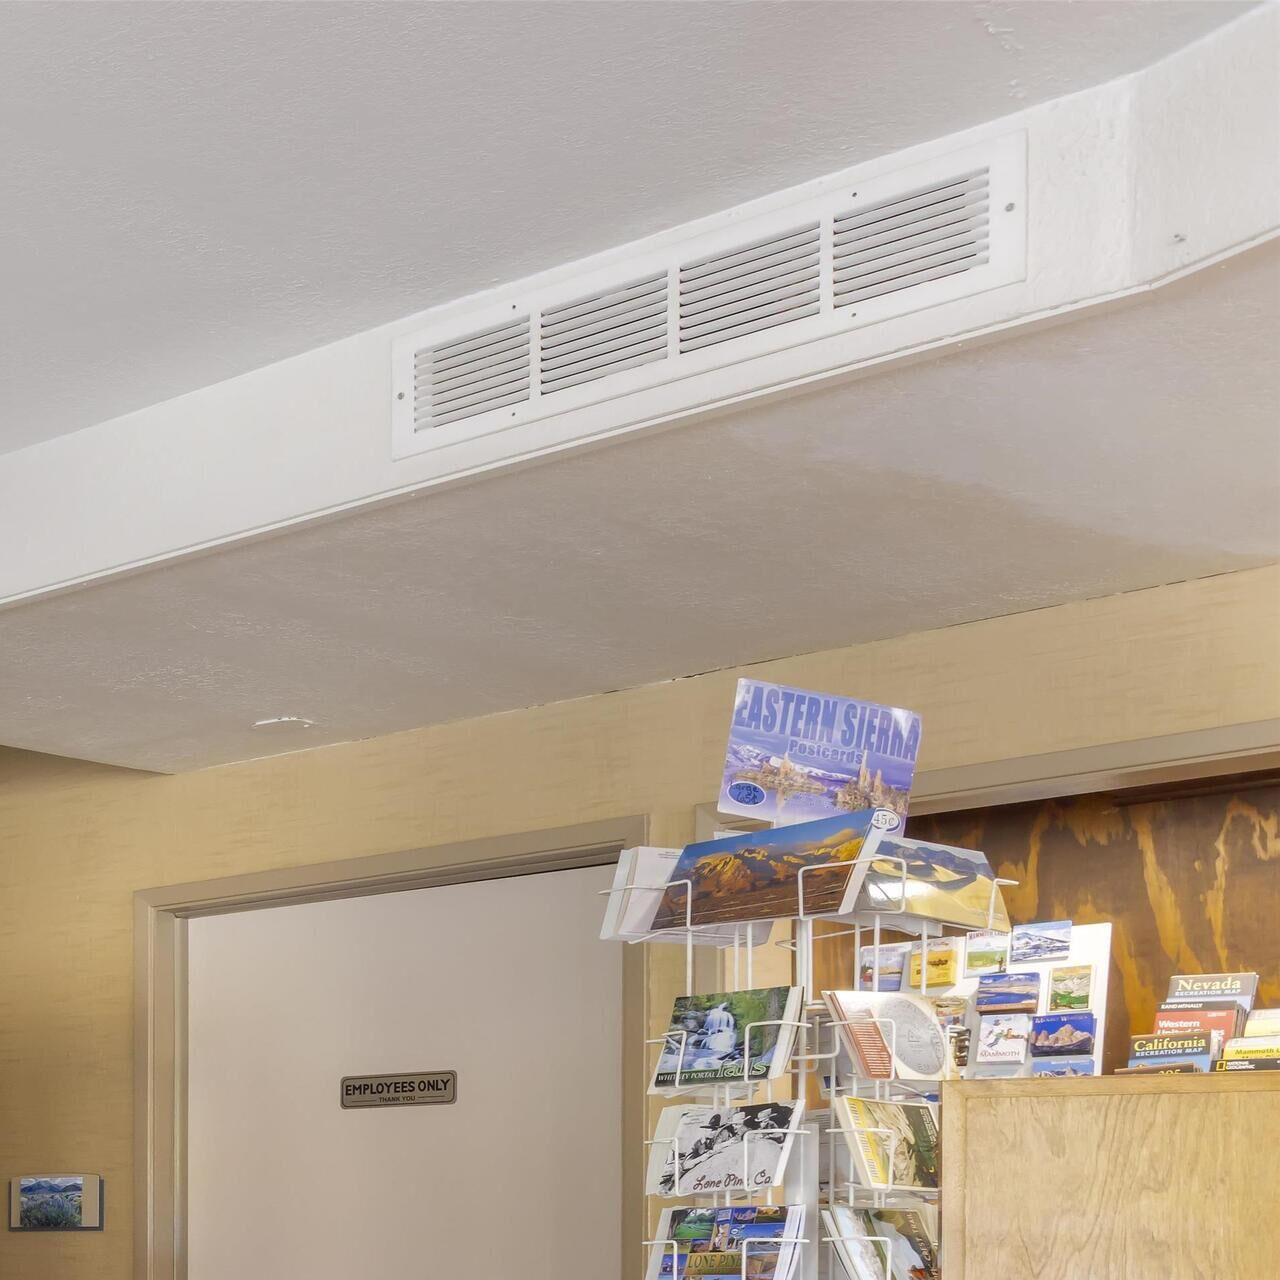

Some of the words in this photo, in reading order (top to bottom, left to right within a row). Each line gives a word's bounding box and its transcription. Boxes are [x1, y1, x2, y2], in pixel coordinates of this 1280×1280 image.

[789, 738, 863, 765] Postcards
[1177, 977, 1241, 991] Nevada
[1158, 1020, 1201, 1028] Western
[1133, 1036, 1206, 1052] California
[979, 1049, 1021, 1059] MAMMOTH
[1135, 1049, 1182, 1057] RECREATION
[345, 1080, 416, 1097] EMPLOYEES
[417, 1078, 451, 1092] ONLY
[693, 1174, 722, 1191] Lone
[688, 1254, 717, 1268] LONE
